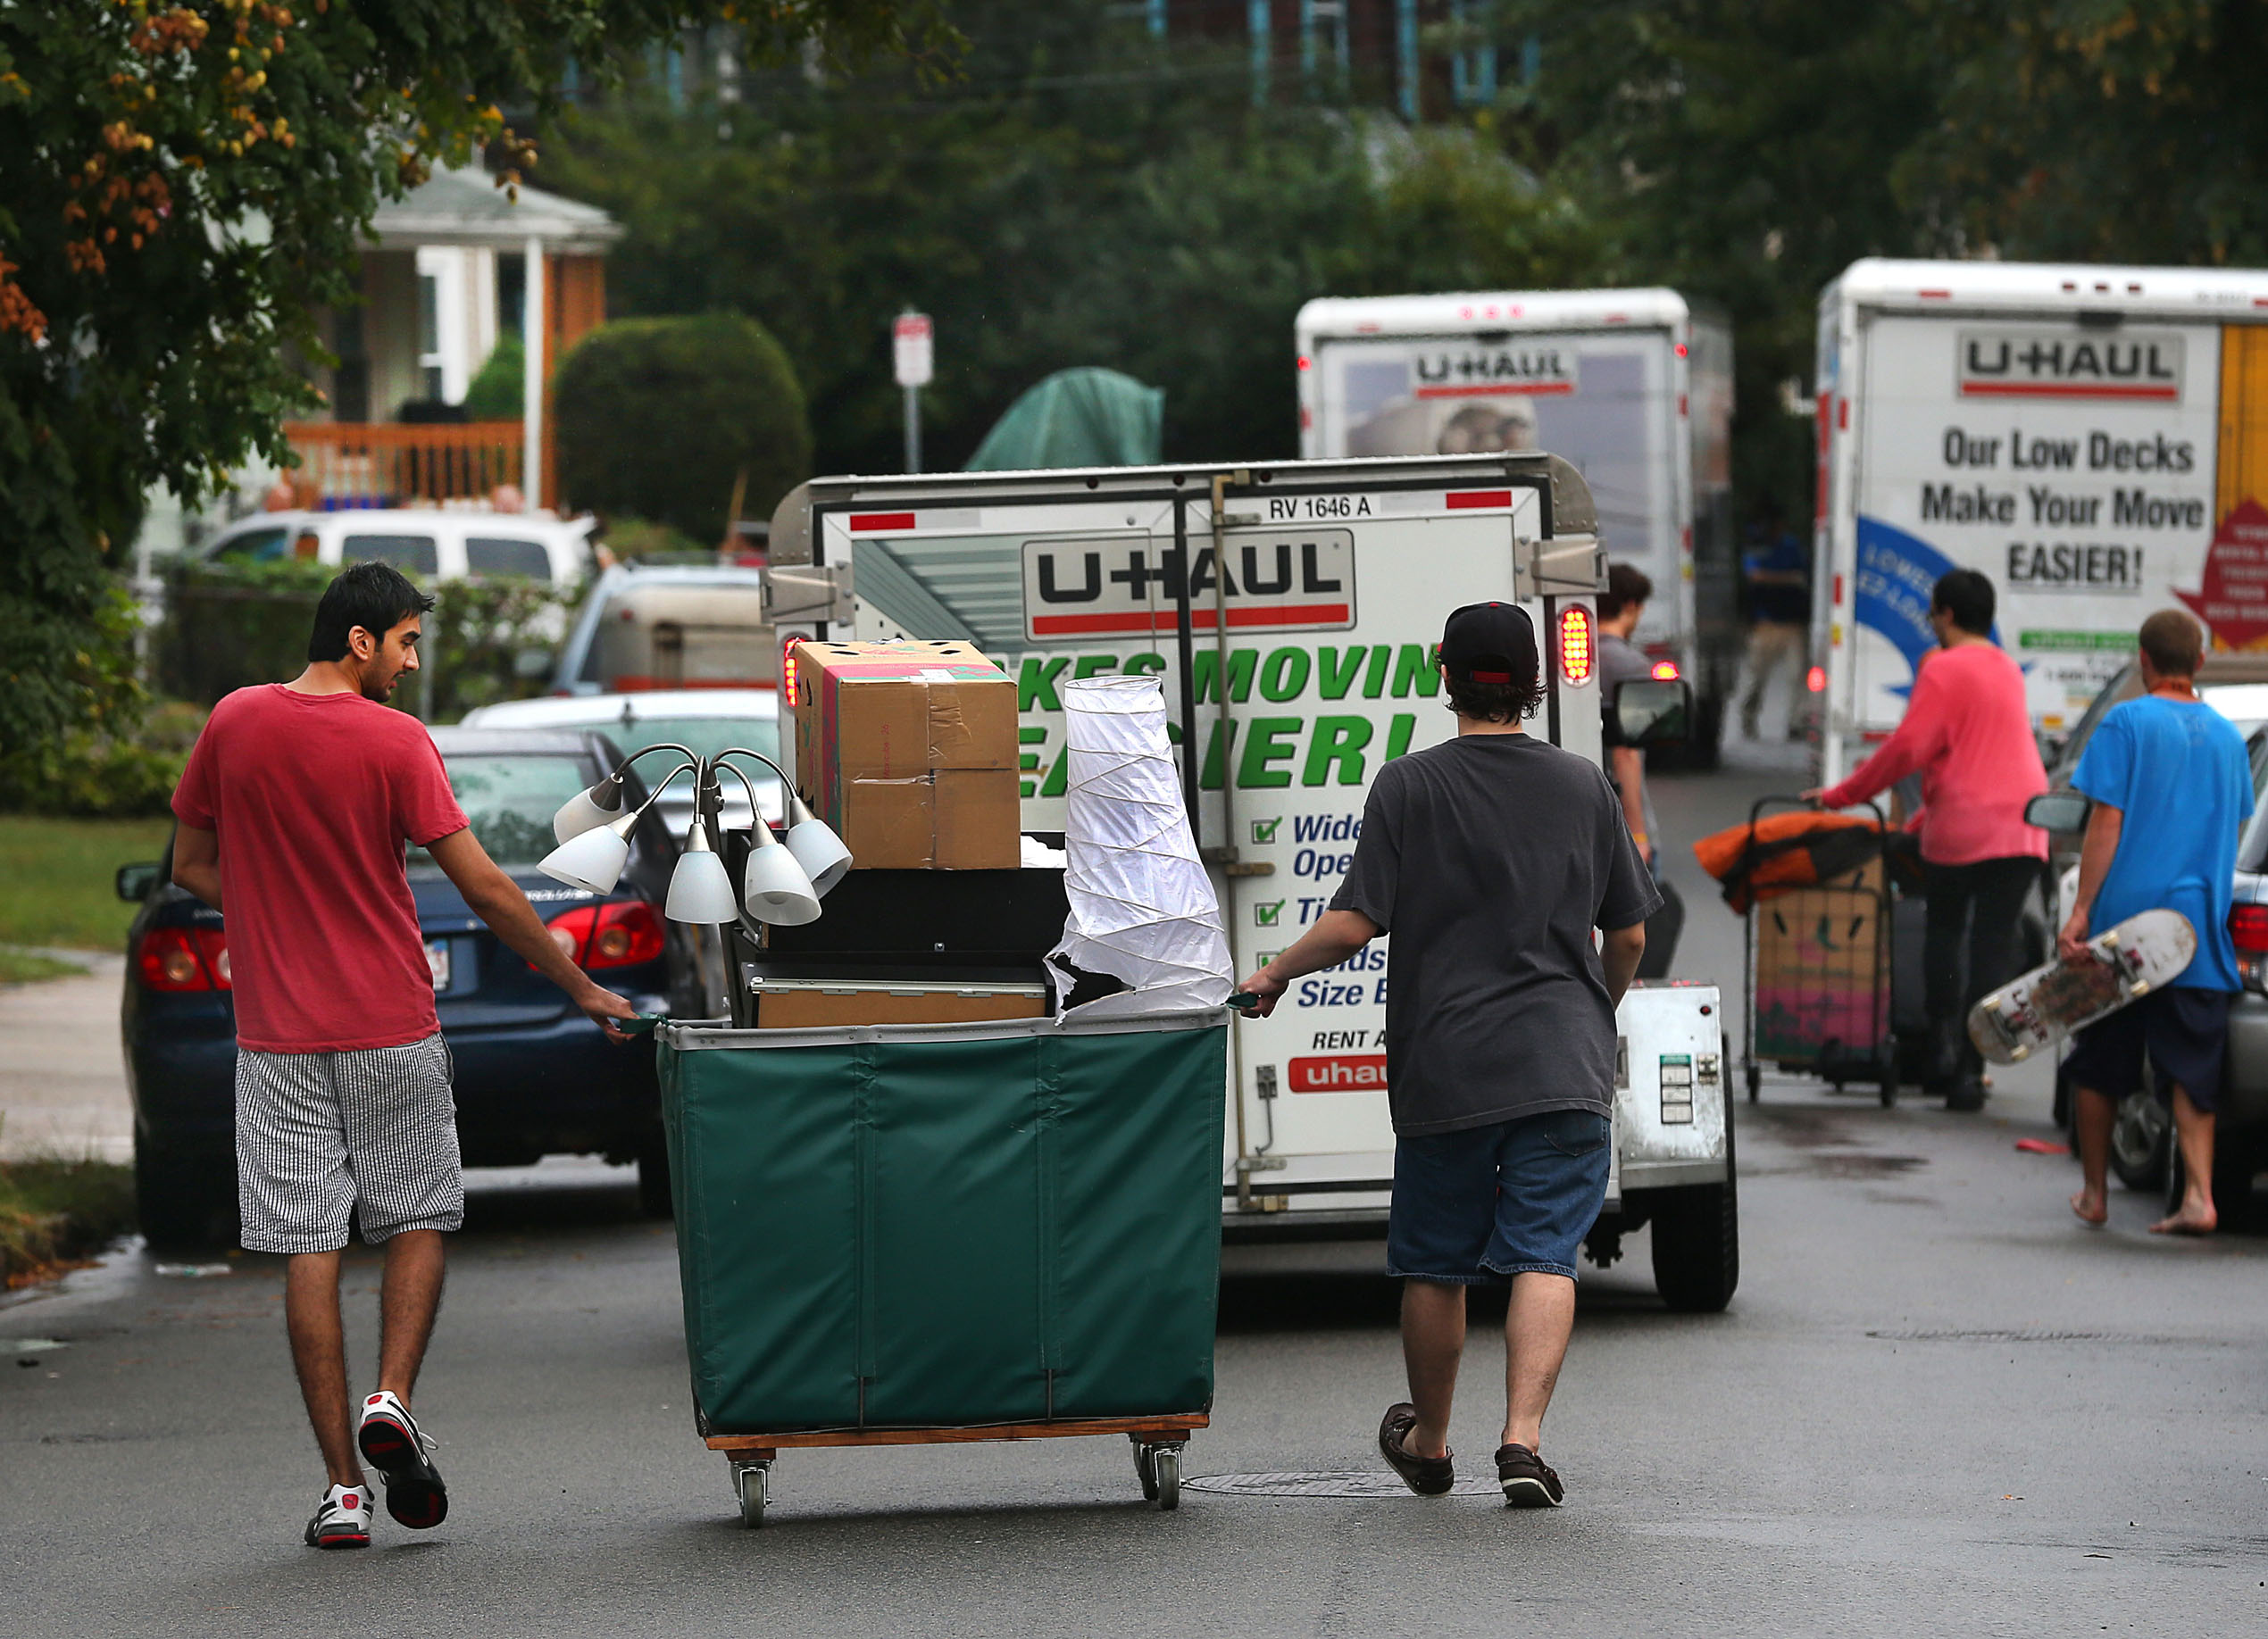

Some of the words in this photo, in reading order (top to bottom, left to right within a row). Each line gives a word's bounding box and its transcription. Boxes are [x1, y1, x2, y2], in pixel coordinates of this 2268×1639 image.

[1943, 427, 2001, 469] Our
[2011, 428, 2078, 470] Low
[2089, 429, 2196, 473] Decks
[1271, 498, 1297, 519] RV
[1305, 496, 1350, 518] 1646
[1357, 495, 1372, 516] A
[1922, 483, 2017, 523] Make
[2028, 485, 2103, 526] Your
[2113, 487, 2205, 529] Move
[2009, 544, 2143, 586] EASIER!
[1193, 644, 1445, 705] MOVIN
[1294, 848, 1354, 883] Ope
[1298, 979, 1364, 1008] Size
[1313, 1029, 1370, 1051] RENT
[1306, 1061, 1388, 1086] uha
